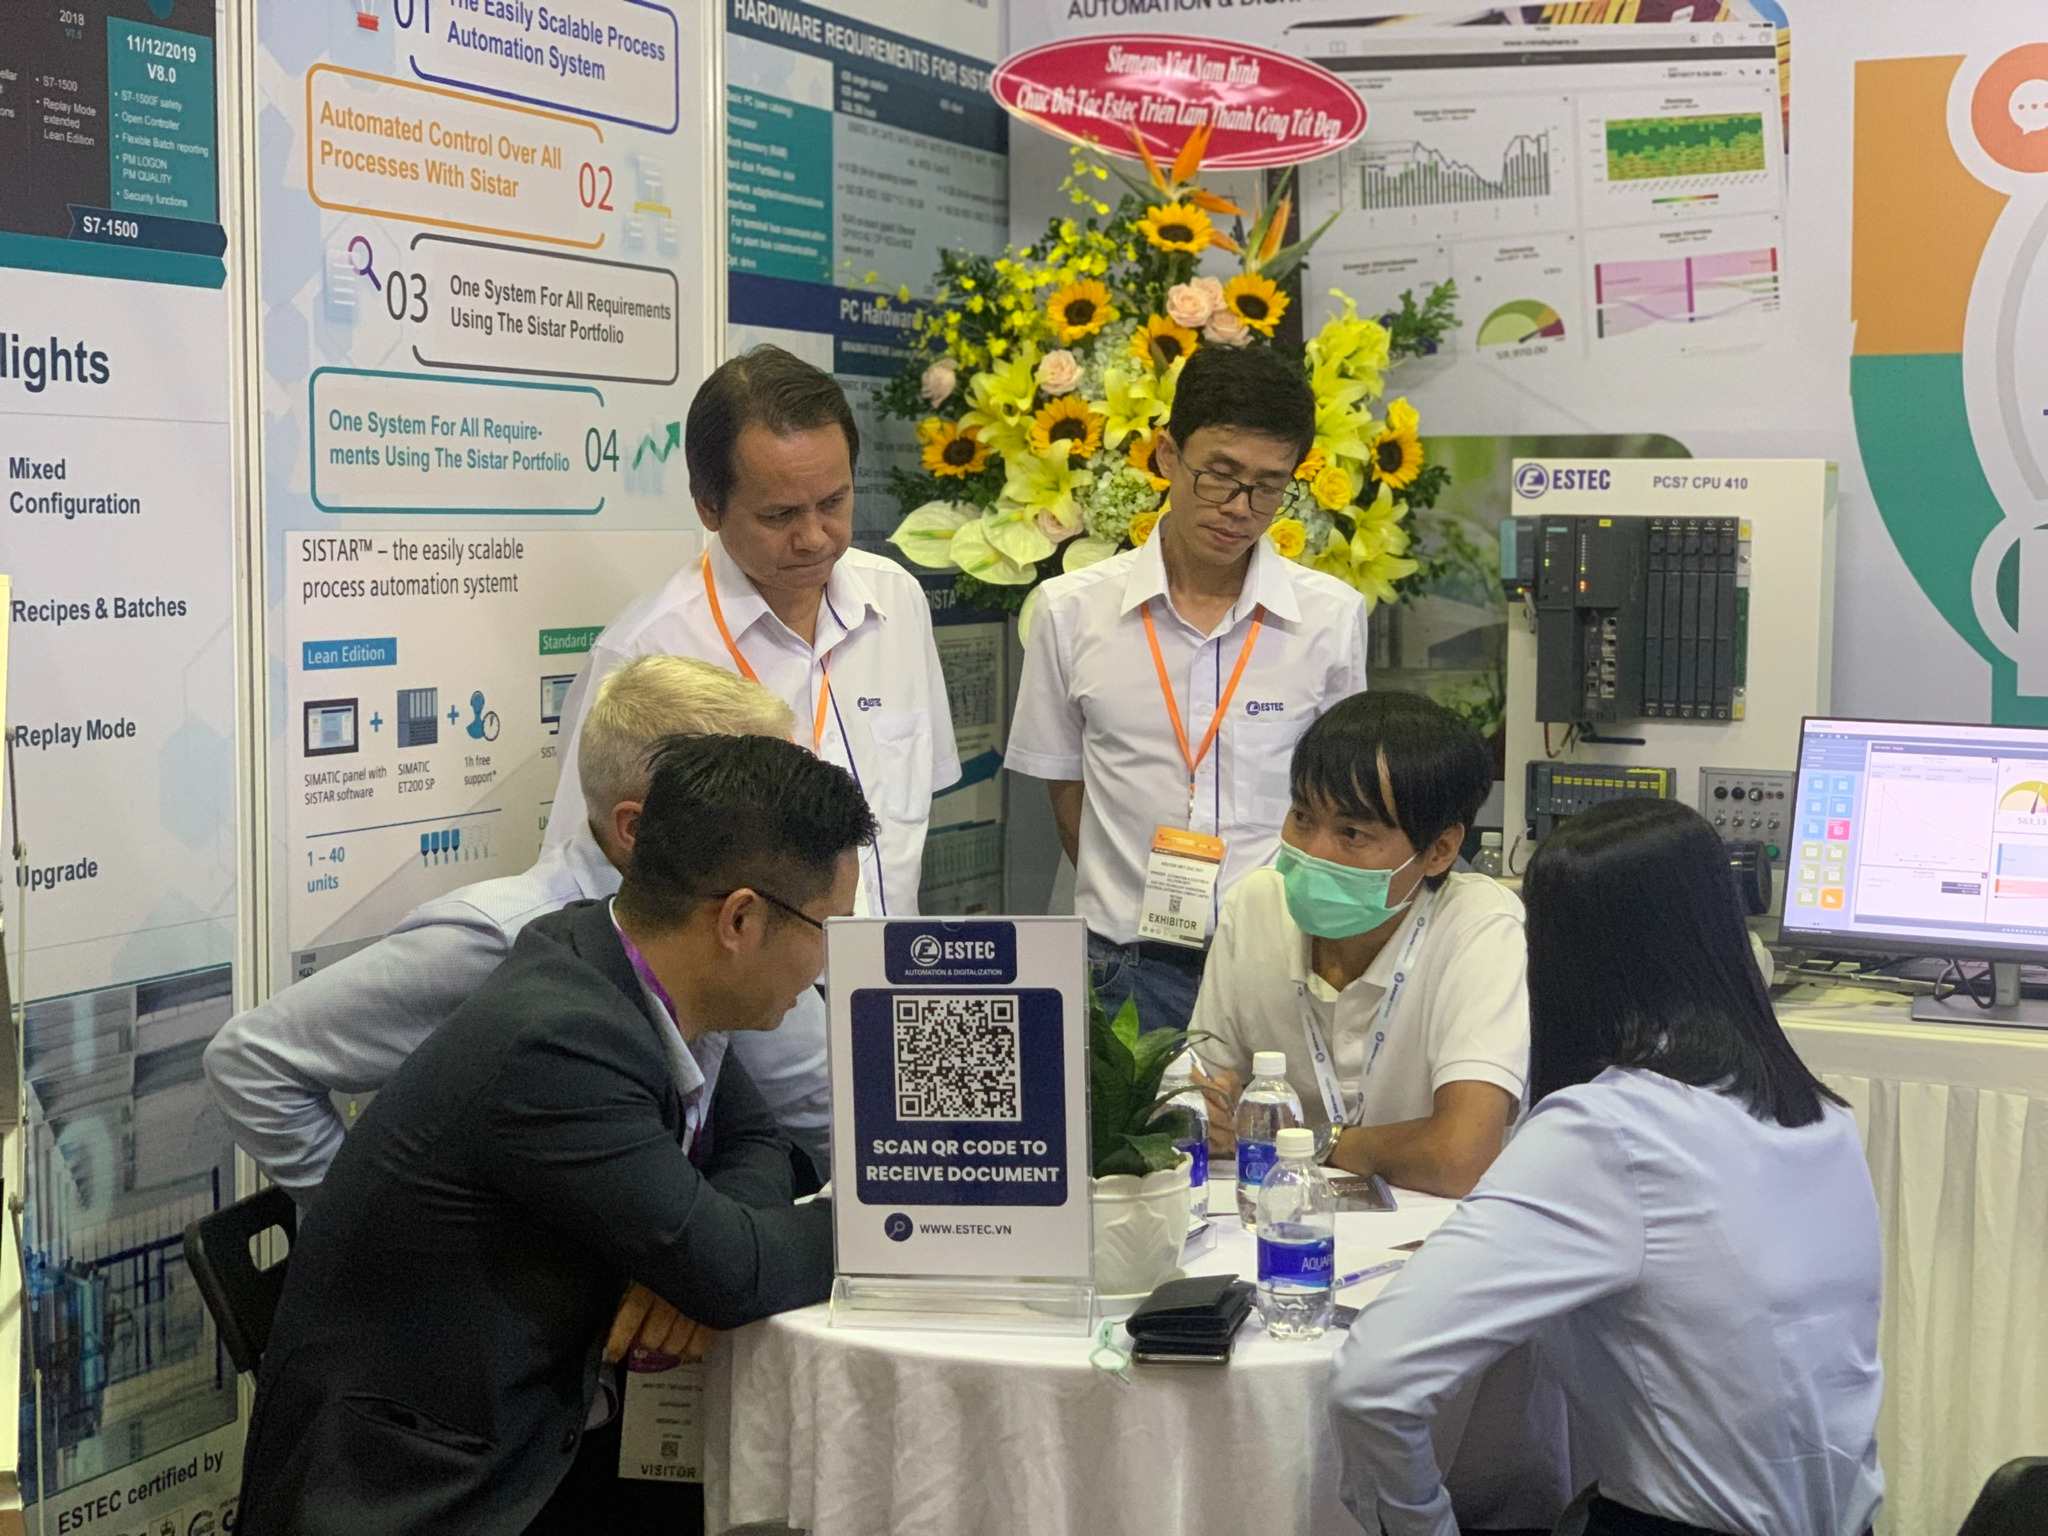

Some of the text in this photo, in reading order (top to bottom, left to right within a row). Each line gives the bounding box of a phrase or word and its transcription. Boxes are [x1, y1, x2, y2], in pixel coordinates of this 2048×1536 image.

[59, 9, 85, 26] 2018
[485, 0, 665, 61] Easily Scalable Process
[734, 0, 822, 43] HARDWARE
[825, 23, 929, 75] REQUIREMENTS
[931, 56, 958, 82] FOR
[127, 35, 197, 63] 11/12/2019
[448, 21, 606, 81] Automation System
[1105, 45, 1163, 73] Siemens
[43, 75, 78, 92] S7-1500
[147, 63, 177, 84] V8.0
[43, 98, 97, 117] Replay Mode
[43, 115, 81, 129] extended
[43, 130, 95, 146] Lean Edition
[320, 100, 561, 170] Automated Control Over All
[320, 140, 519, 198] Processes With Sistar
[123, 189, 153, 204] Security
[579, 162, 613, 211] 02
[82, 215, 139, 239] S7-1500
[386, 271, 429, 323] 03
[450, 275, 671, 320] One System For All Requirements
[839, 298, 860, 322] PC
[450, 307, 624, 344] Using The Sistar Portfolio
[0, 333, 110, 393] lights
[329, 409, 543, 442] One System For All Require-
[330, 446, 570, 472] ments Using The Sistar Portfolio
[585, 428, 619, 472] 04
[9, 456, 66, 480] Mixed
[1553, 469, 1610, 490] ESTEC
[1653, 476, 1748, 489] PCS7 CPU 410
[9, 491, 141, 520] Configuration
[392, 538, 418, 560] the
[422, 538, 464, 566] easily
[467, 537, 524, 560] scalable
[303, 572, 519, 604] process automation systemt
[12, 596, 187, 626] Recipes & Batches
[542, 632, 588, 650] Standard
[307, 645, 385, 665] Lean Edition
[1261, 702, 1284, 711] ESTEC
[15, 717, 136, 750] Replay Mode
[398, 760, 430, 776] SIMATIC
[475, 754, 491, 766] free
[304, 766, 387, 787] SIMATIC panel with
[398, 778, 436, 793] ET200 SP
[304, 787, 374, 805] SISTAR software
[15, 857, 98, 891] Upgrade
[307, 873, 339, 893] units
[1148, 912, 1198, 930] EXHIBITOR
[944, 941, 995, 959] ESTEC
[953, 968, 1003, 976] DIGITALIZATION
[872, 1140, 1047, 1157] SCAN QR CODE TO
[866, 1166, 1060, 1182] RECEIVE DOCUMENT
[919, 1223, 1012, 1235] WWW.ESTEC.VN
[641, 1463, 697, 1479] VISITOR
[58, 1451, 224, 1535] ESTEC certified by
